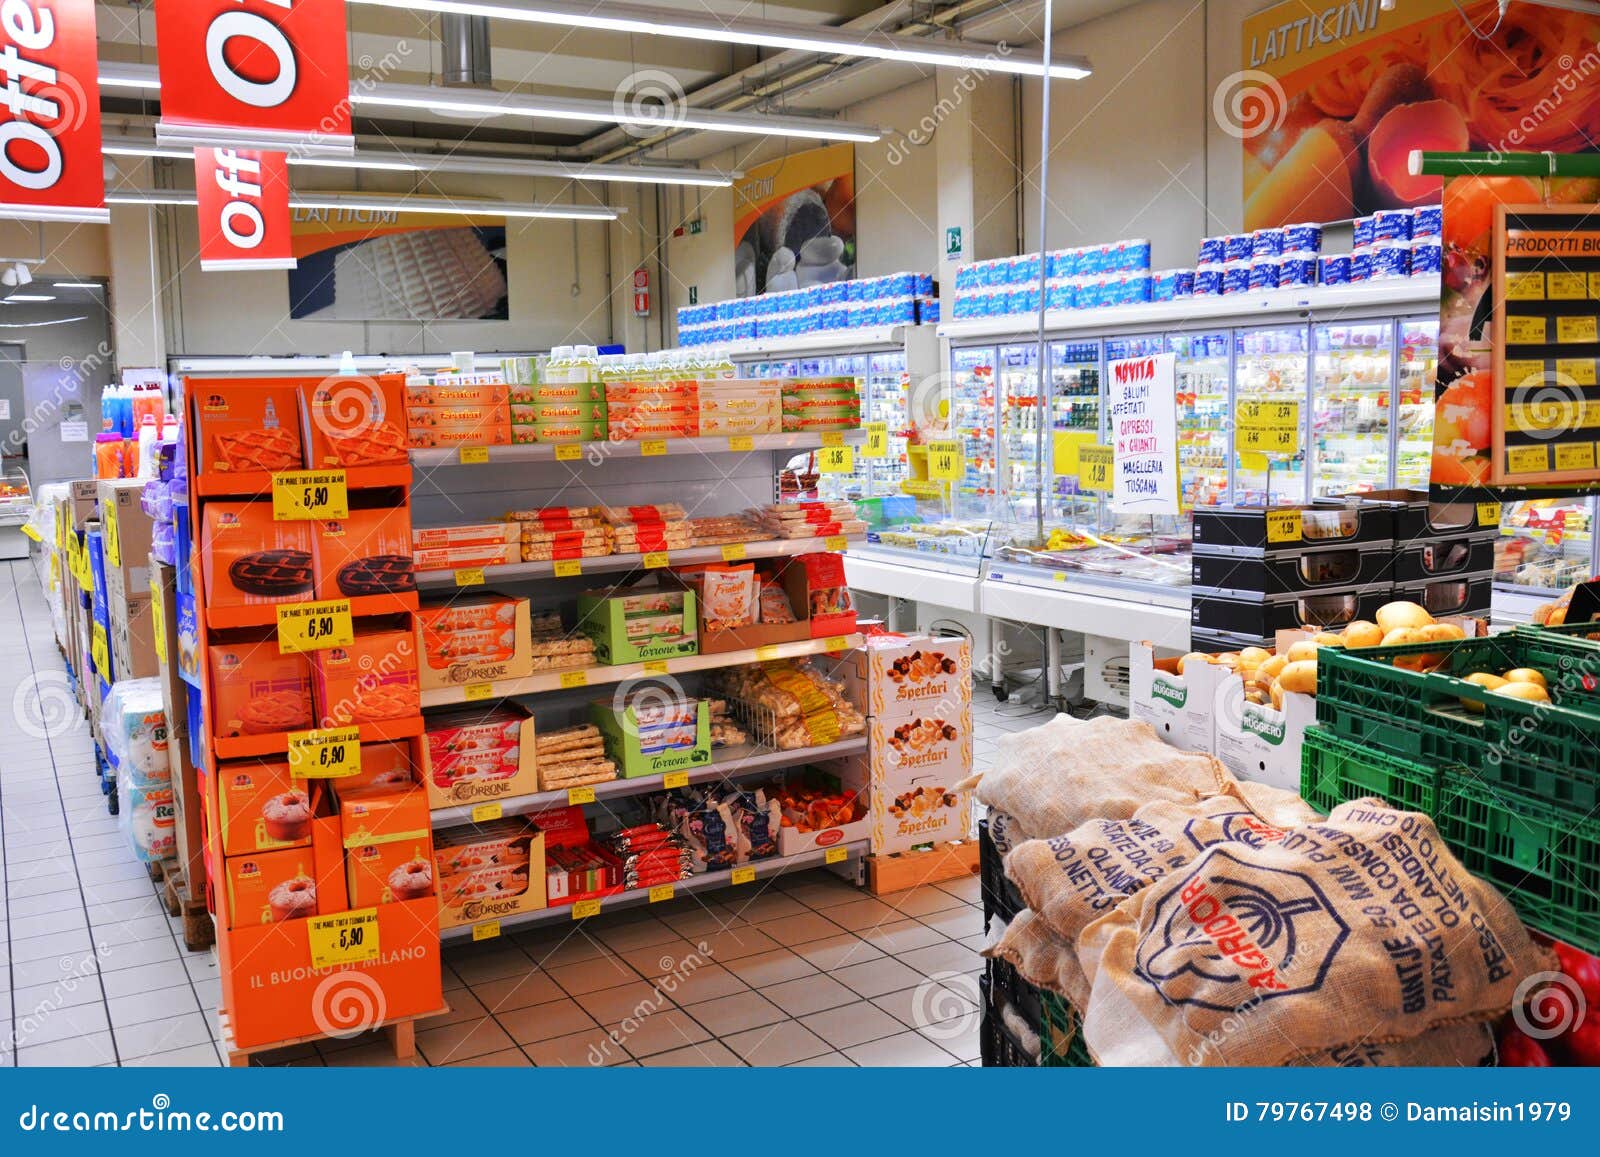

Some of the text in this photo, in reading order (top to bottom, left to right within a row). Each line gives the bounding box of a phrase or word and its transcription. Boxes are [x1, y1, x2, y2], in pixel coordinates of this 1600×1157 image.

[1251, 0, 1381, 67] LATTICINI
[1506, 238, 1579, 252] PRODOTTI
[1123, 385, 1149, 400] SALUMI
[303, 486, 329, 510] 5,90
[1125, 478, 1158, 495] TOSCANA
[308, 616, 334, 640] 6,90
[896, 680, 948, 701] Sperlari
[1153, 683, 1185, 702] RUGGIERO
[1242, 715, 1282, 739] RUGGIERO
[320, 745, 345, 768] 6,90
[897, 747, 948, 770] Sperlari
[897, 814, 948, 836] Sperlari
[1346, 808, 1398, 826] CHILI
[1376, 832, 1461, 930] OLANDESI
[1419, 837, 1470, 912] NETTO
[1390, 888, 1422, 920] DA
[1362, 905, 1397, 930] 50
[339, 926, 364, 951] 5,90
[1469, 912, 1512, 984] PESO
[250, 975, 264, 989] IL
[362, 946, 427, 971] MILANO
[1412, 920, 1457, 1003] PATATE
[1383, 938, 1427, 1016] BINTJE
